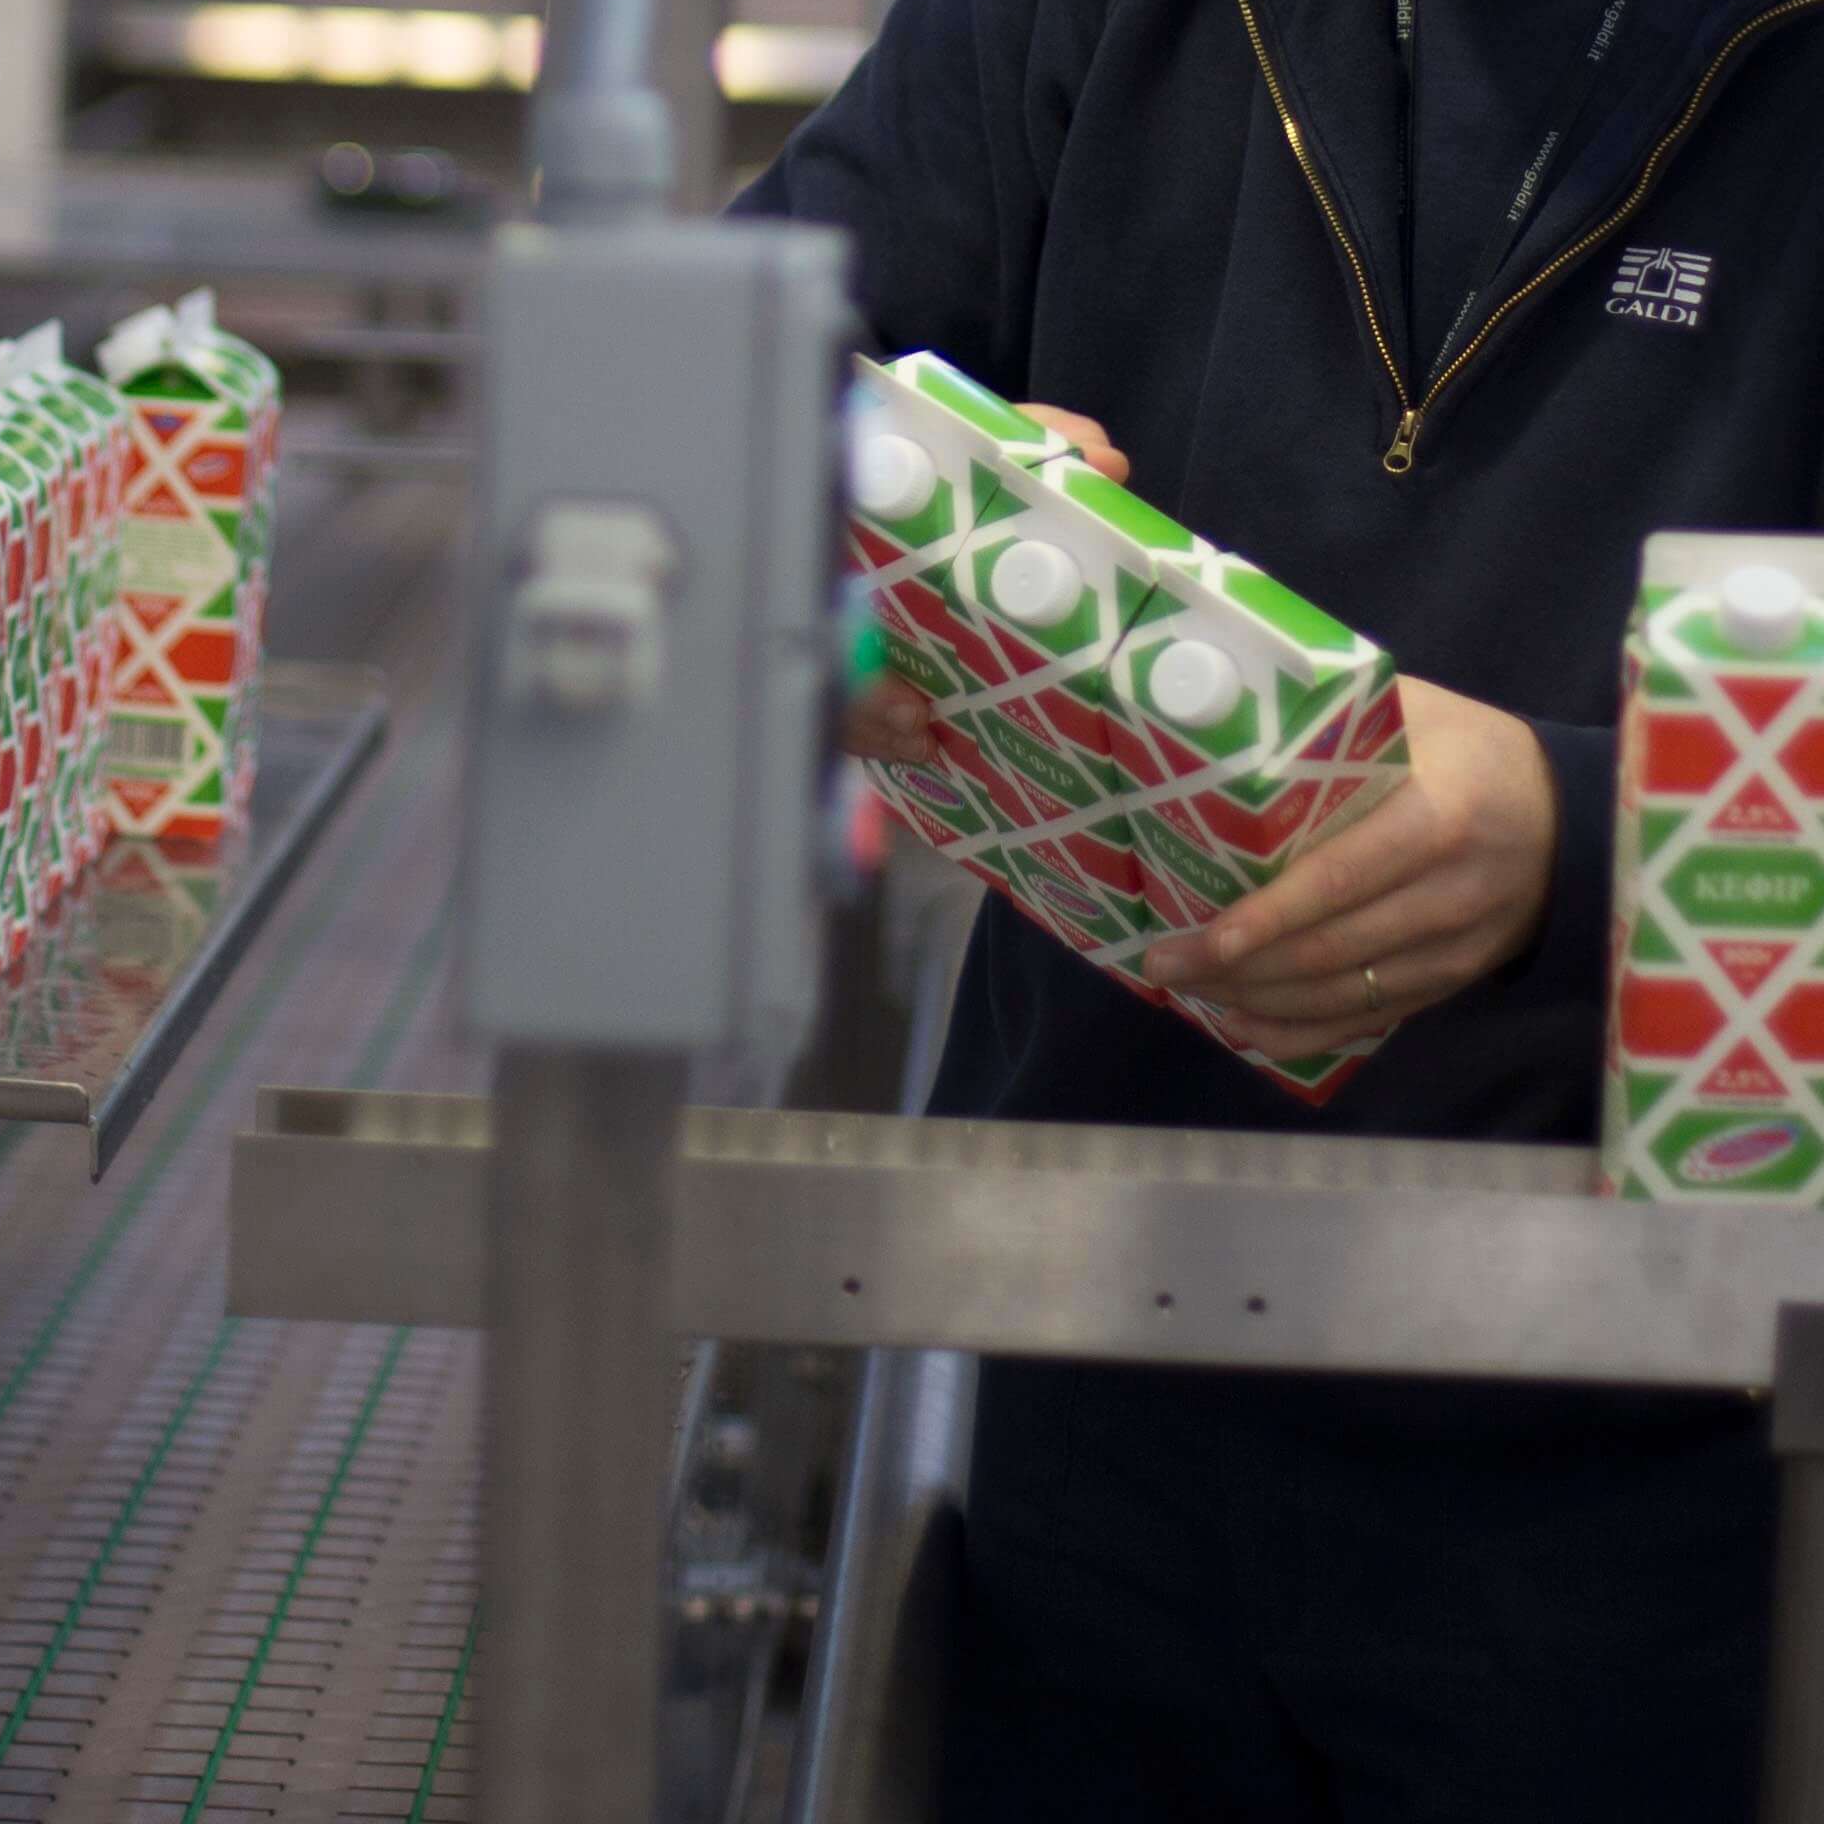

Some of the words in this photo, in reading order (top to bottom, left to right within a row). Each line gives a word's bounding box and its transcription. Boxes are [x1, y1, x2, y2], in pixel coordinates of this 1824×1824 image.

[1507, 131, 1559, 221] www.galdi.it
[1606, 298, 1697, 326] GALDI
[1695, 874, 1811, 903] КЕФІР
